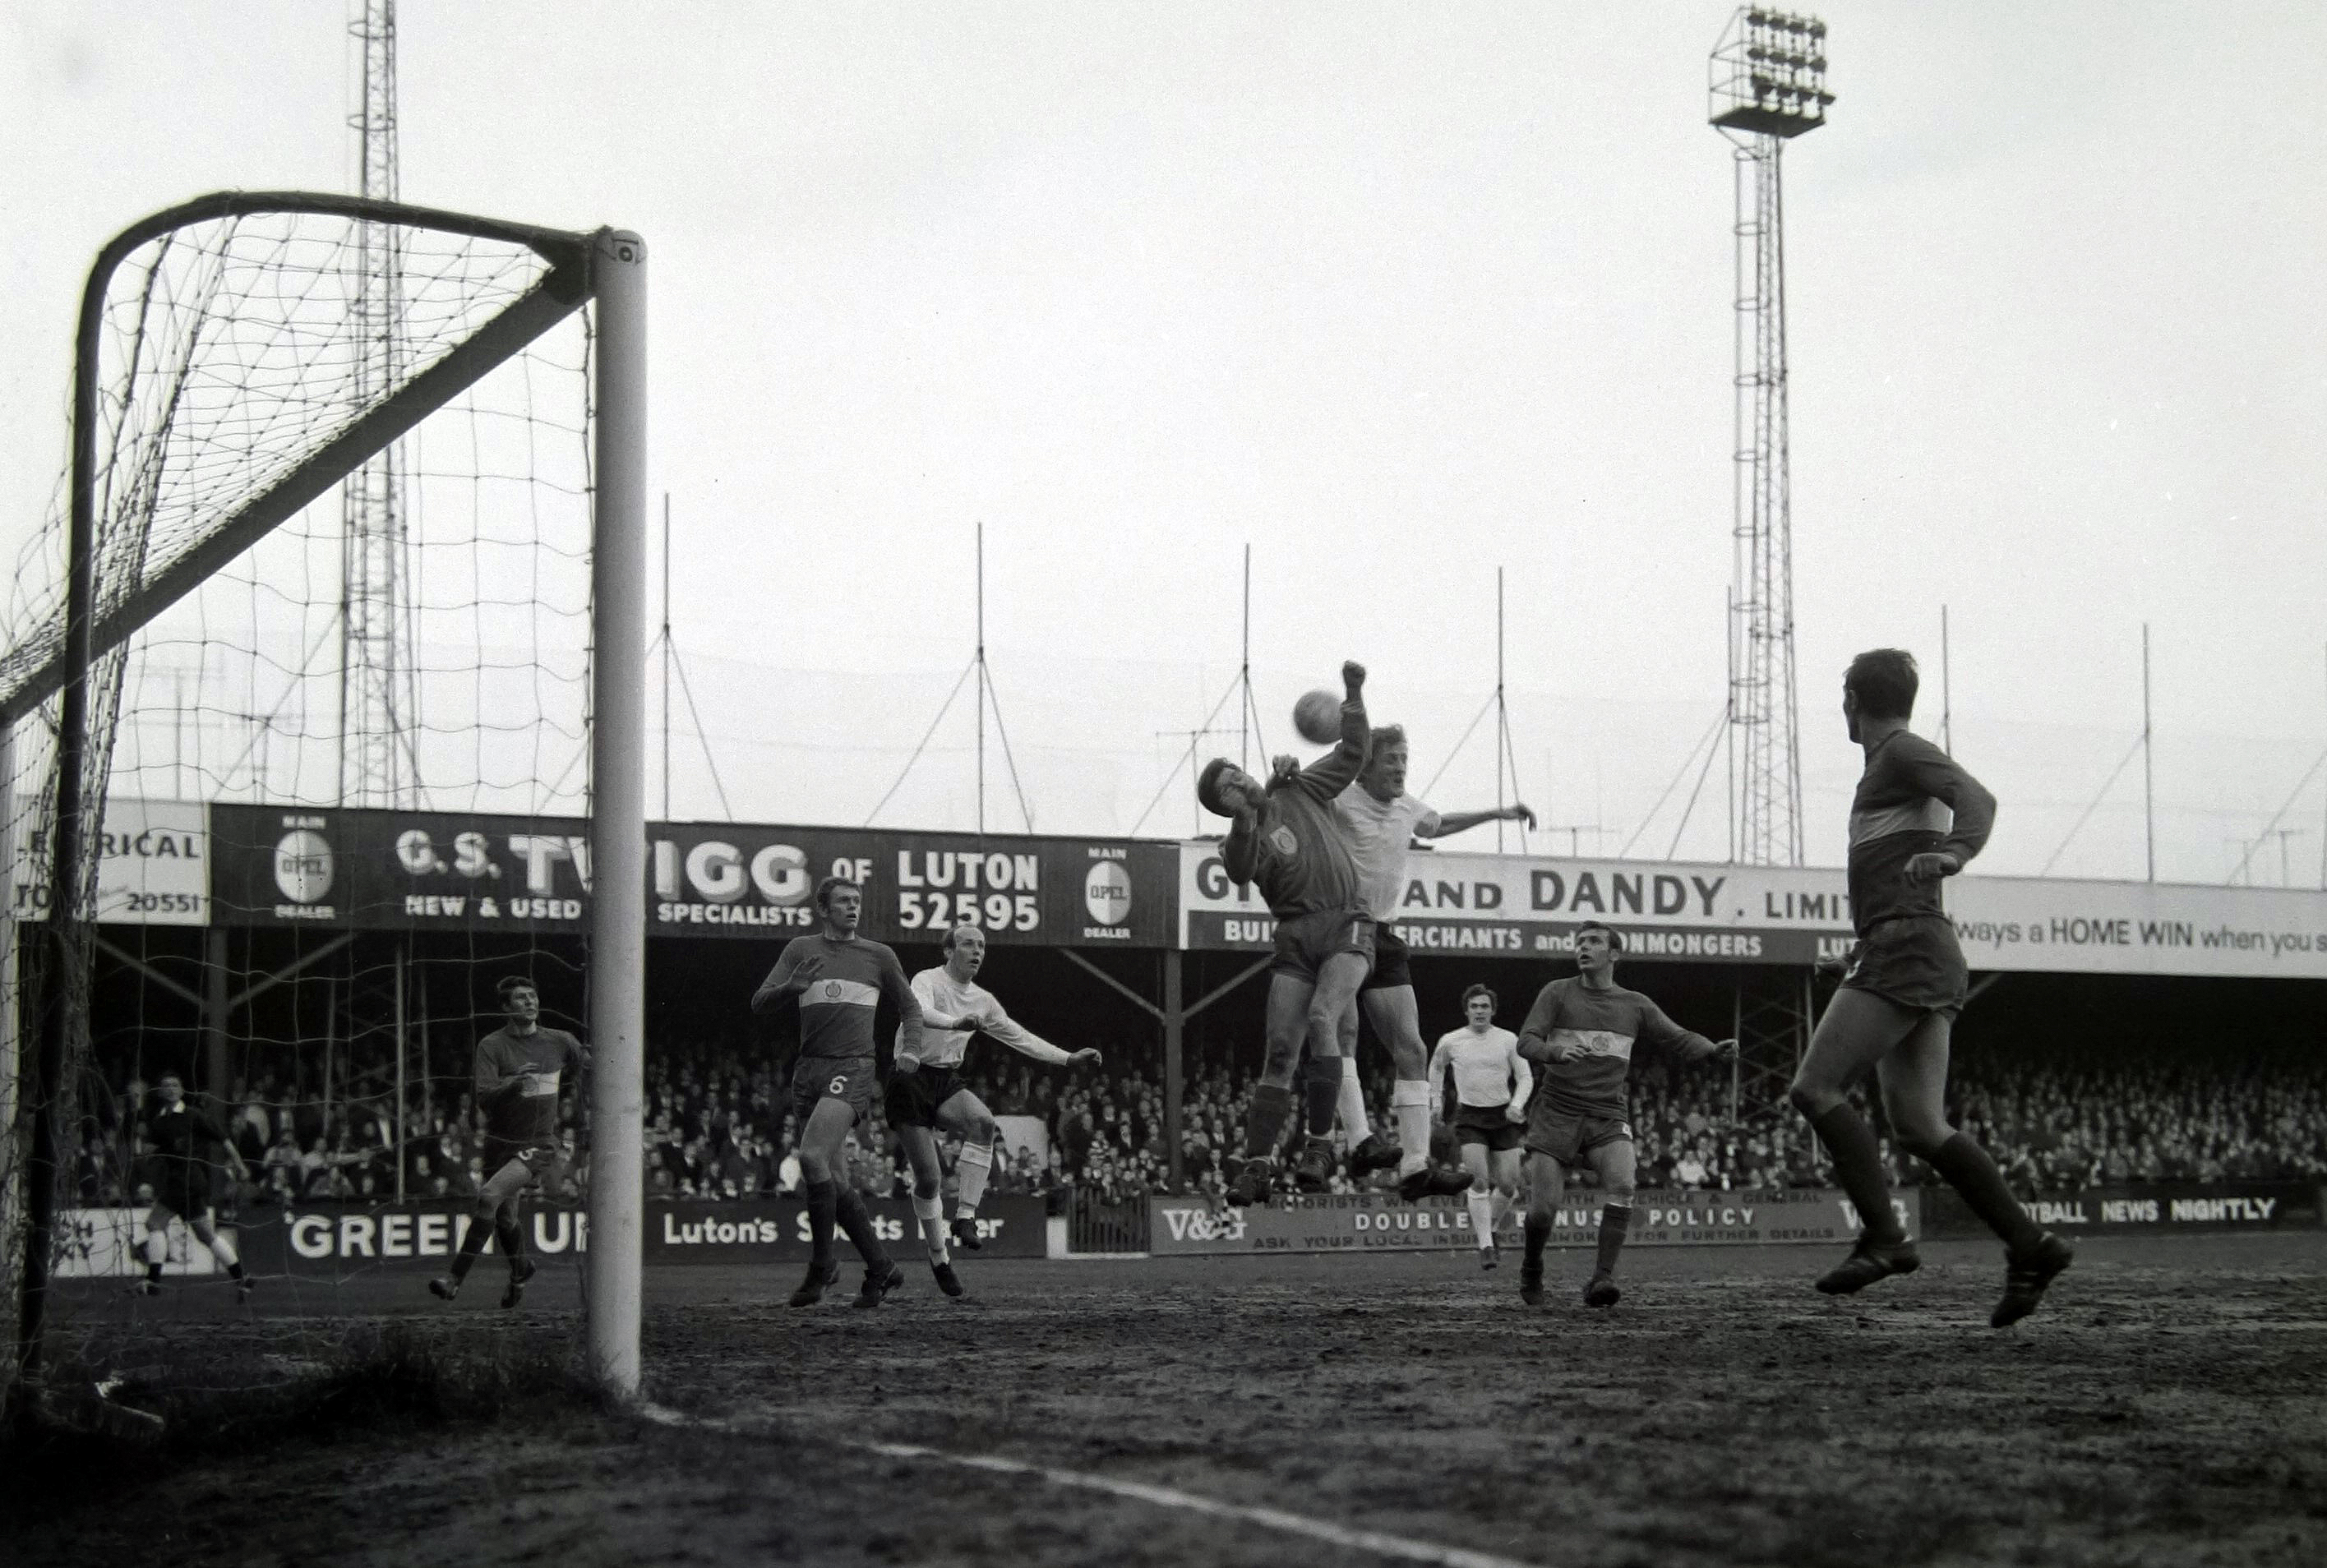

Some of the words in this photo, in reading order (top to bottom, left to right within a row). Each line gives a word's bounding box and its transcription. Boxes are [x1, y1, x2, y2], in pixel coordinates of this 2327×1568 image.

[1088, 847, 1127, 860] MAIN
[832, 857, 872, 886] OF
[898, 851, 1038, 891] LUTON
[127, 892, 199, 912] 20551
[1091, 884, 1129, 902] OPEL
[1402, 879, 1504, 910] AND
[405, 895, 466, 915] NEW
[480, 896, 500, 918] &
[511, 898, 582, 919] USED
[658, 904, 813, 926] SPECIALISTS
[898, 893, 1039, 931] 52595
[1083, 926, 1130, 939] DEALER
[1389, 925, 1523, 950] ERCHANTS
[1951, 915, 2022, 950] ways
[2029, 925, 2043, 943] a
[2051, 917, 2131, 945] HOME
[2138, 920, 2193, 948] WIN
[2200, 925, 2265, 951] when
[2270, 931, 2311, 958] you
[829, 1075, 847, 1095] 6
[1354, 1210, 1470, 1230] DOUBLE
[1649, 1206, 1754, 1227] POLICY
[2102, 1200, 2158, 1223] NEWS
[2170, 1197, 2276, 1222] NIGHTLY
[663, 1211, 778, 1245] Luton's
